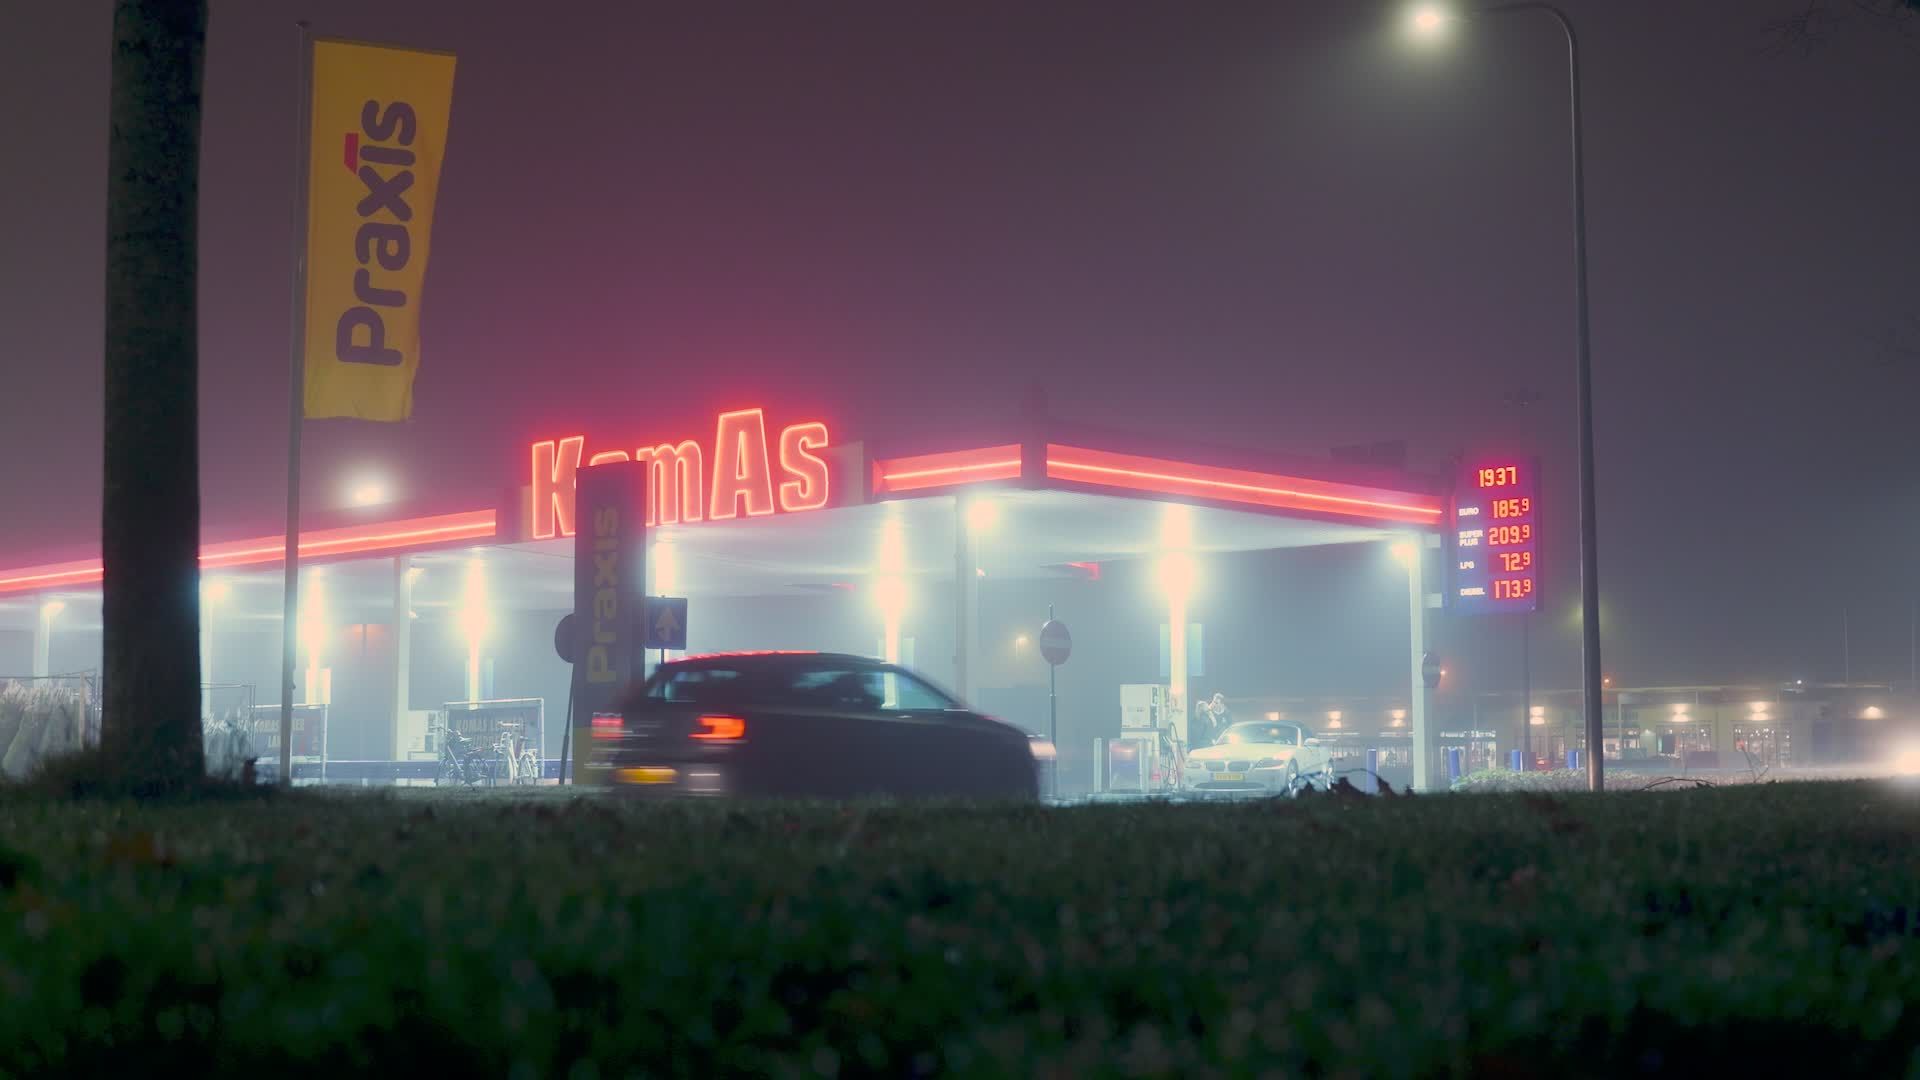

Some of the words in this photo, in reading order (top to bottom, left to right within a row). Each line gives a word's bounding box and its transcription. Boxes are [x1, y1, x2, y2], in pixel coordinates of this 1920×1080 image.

[336, 99, 417, 366] Praxis
[532, 408, 829, 540] KmAs
[1459, 507, 1479, 516] EURO
[1493, 498, 1530, 518] 185.9
[1489, 525, 1530, 545] 209.9
[1500, 552, 1531, 572] 72.9
[588, 506, 619, 683] Praxis
[1495, 579, 1531, 599] 173.9
